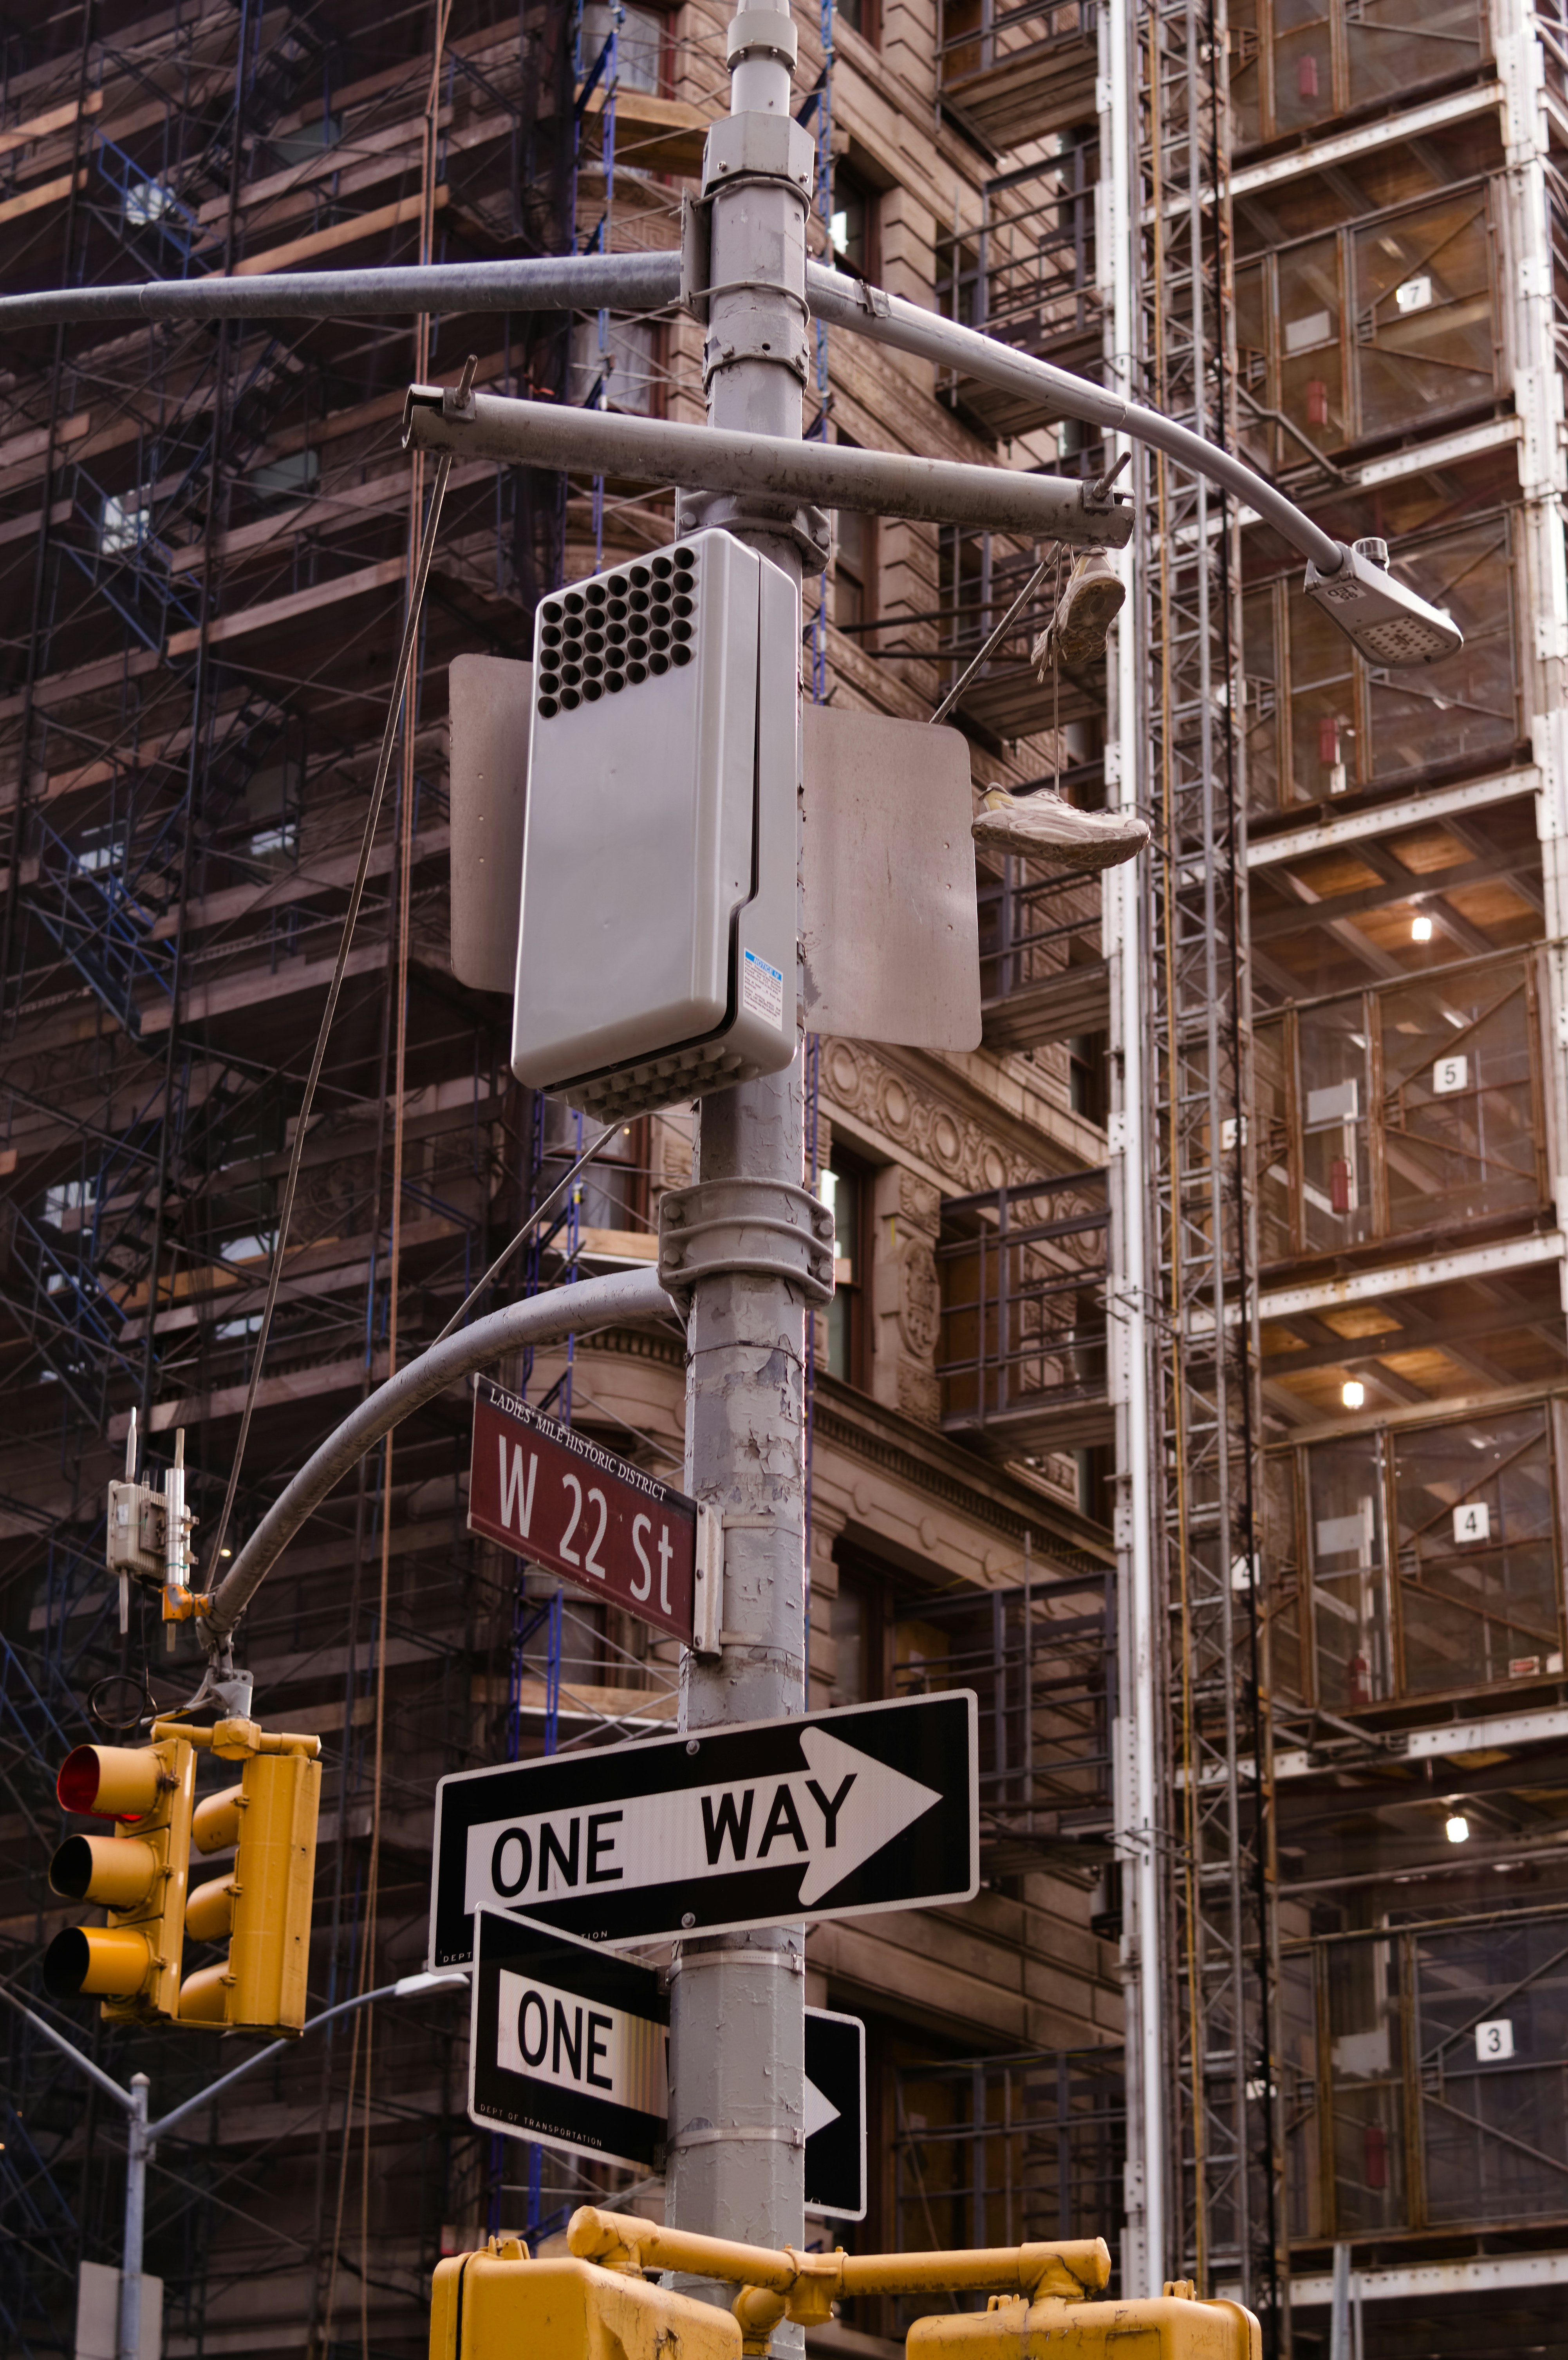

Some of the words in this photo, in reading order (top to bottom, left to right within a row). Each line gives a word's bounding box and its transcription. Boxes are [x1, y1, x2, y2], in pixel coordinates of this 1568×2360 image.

[1409, 285, 1420, 304] 7
[1328, 584, 1358, 597] LED
[1445, 1063, 1456, 1085] 5
[535, 1415, 564, 1443] MILE
[565, 1432, 617, 1473] HISTORIC
[617, 1462, 667, 1501] DISTRICT
[499, 1434, 538, 1539] W
[559, 1473, 607, 1580] 22
[630, 1513, 673, 1615] St
[1465, 1511, 1477, 1533] 4
[491, 1810, 623, 1898] ONE
[701, 1773, 858, 1866] WAY
[443, 1951, 473, 1963] DEPT
[517, 1990, 613, 2091] ONE
[1488, 2028, 1501, 2053] 3
[480, 2103, 503, 2117] DEPT
[508, 2112, 519, 2121] OF
[524, 2116, 602, 2147] TRANSPORTATION
